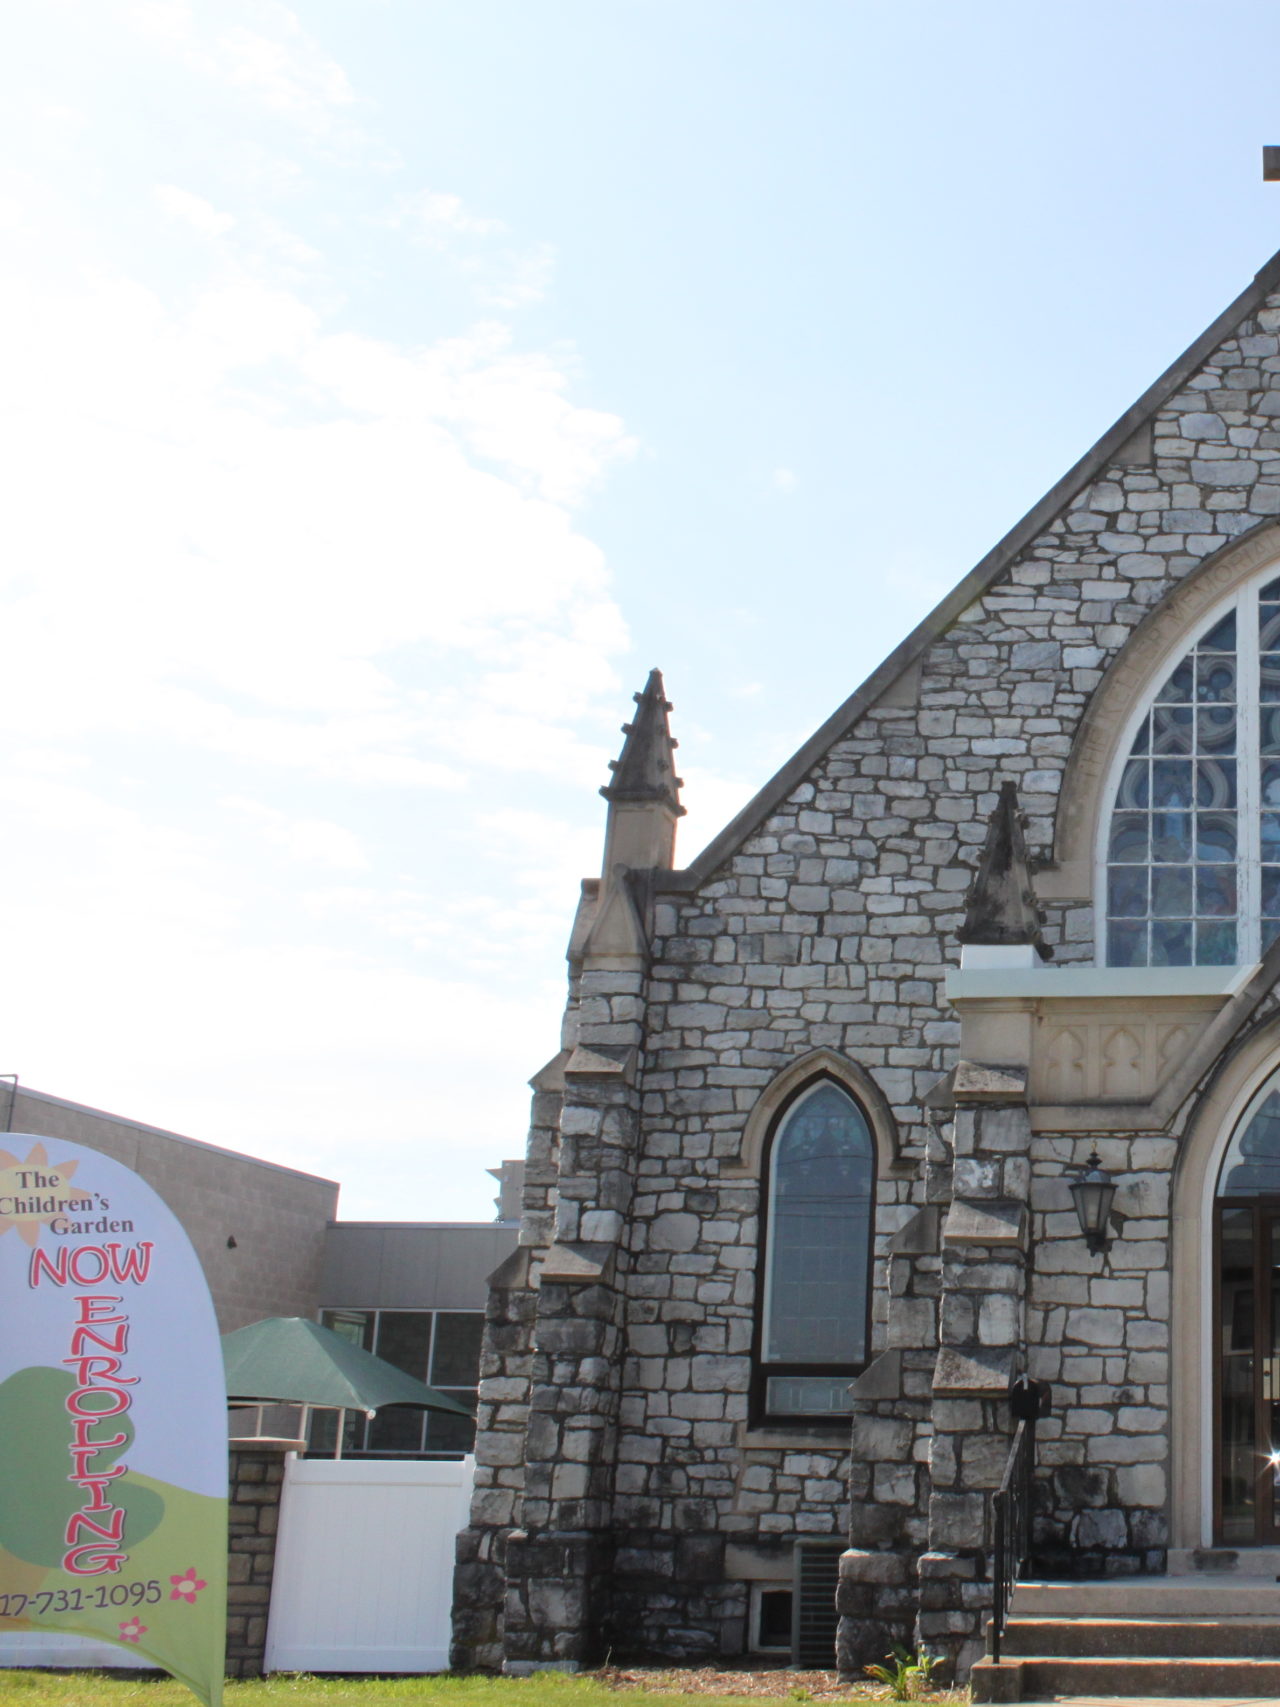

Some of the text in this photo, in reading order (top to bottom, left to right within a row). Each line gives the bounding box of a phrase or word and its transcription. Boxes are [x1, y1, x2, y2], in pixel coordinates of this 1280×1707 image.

[15, 1171, 60, 1189] The
[0, 1192, 110, 1215] Children's
[50, 1216, 134, 1236] Garden
[30, 1242, 154, 1288] NOW
[62, 1295, 139, 1576] ENROLLING
